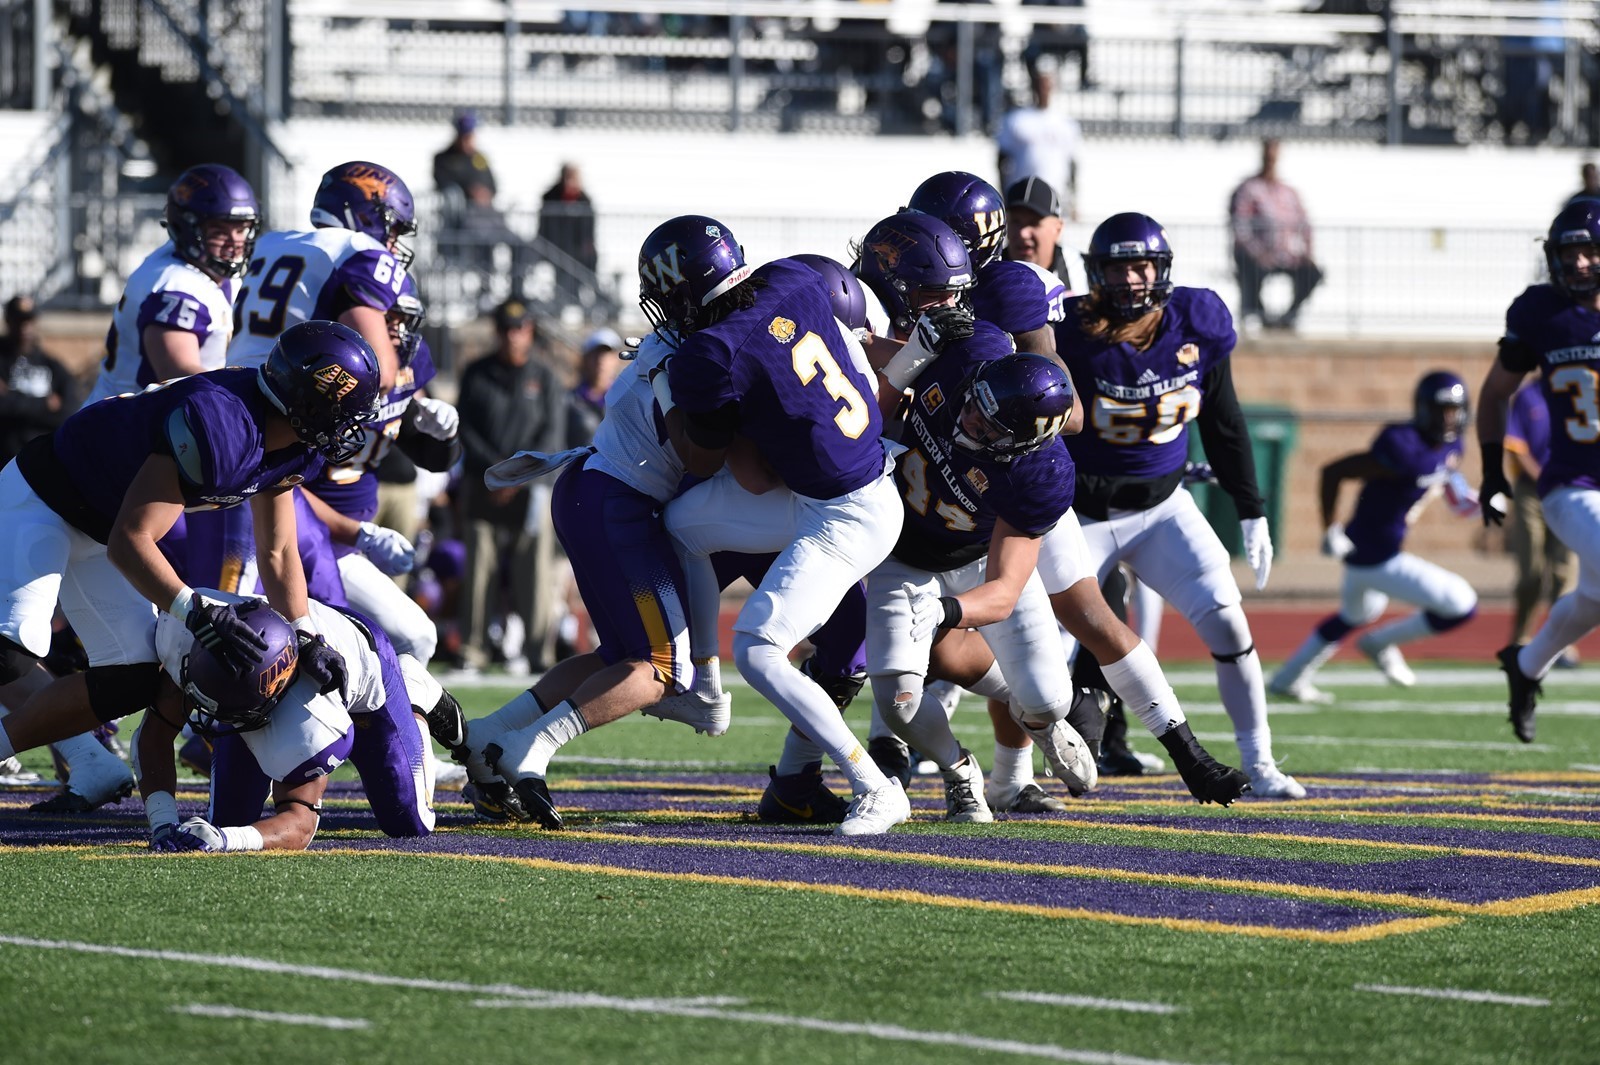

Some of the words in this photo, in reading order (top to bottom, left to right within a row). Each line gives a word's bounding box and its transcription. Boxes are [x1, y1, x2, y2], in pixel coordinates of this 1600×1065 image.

[373, 253, 406, 295] 69
[641, 242, 686, 295] W
[155, 293, 201, 330] 75
[791, 331, 869, 439] 3
[1091, 385, 1201, 445] 50
[1548, 363, 1600, 443] 3
[901, 448, 978, 532] 44
[910, 408, 945, 465] WESTERN
[941, 463, 978, 513] ILLINOIS
